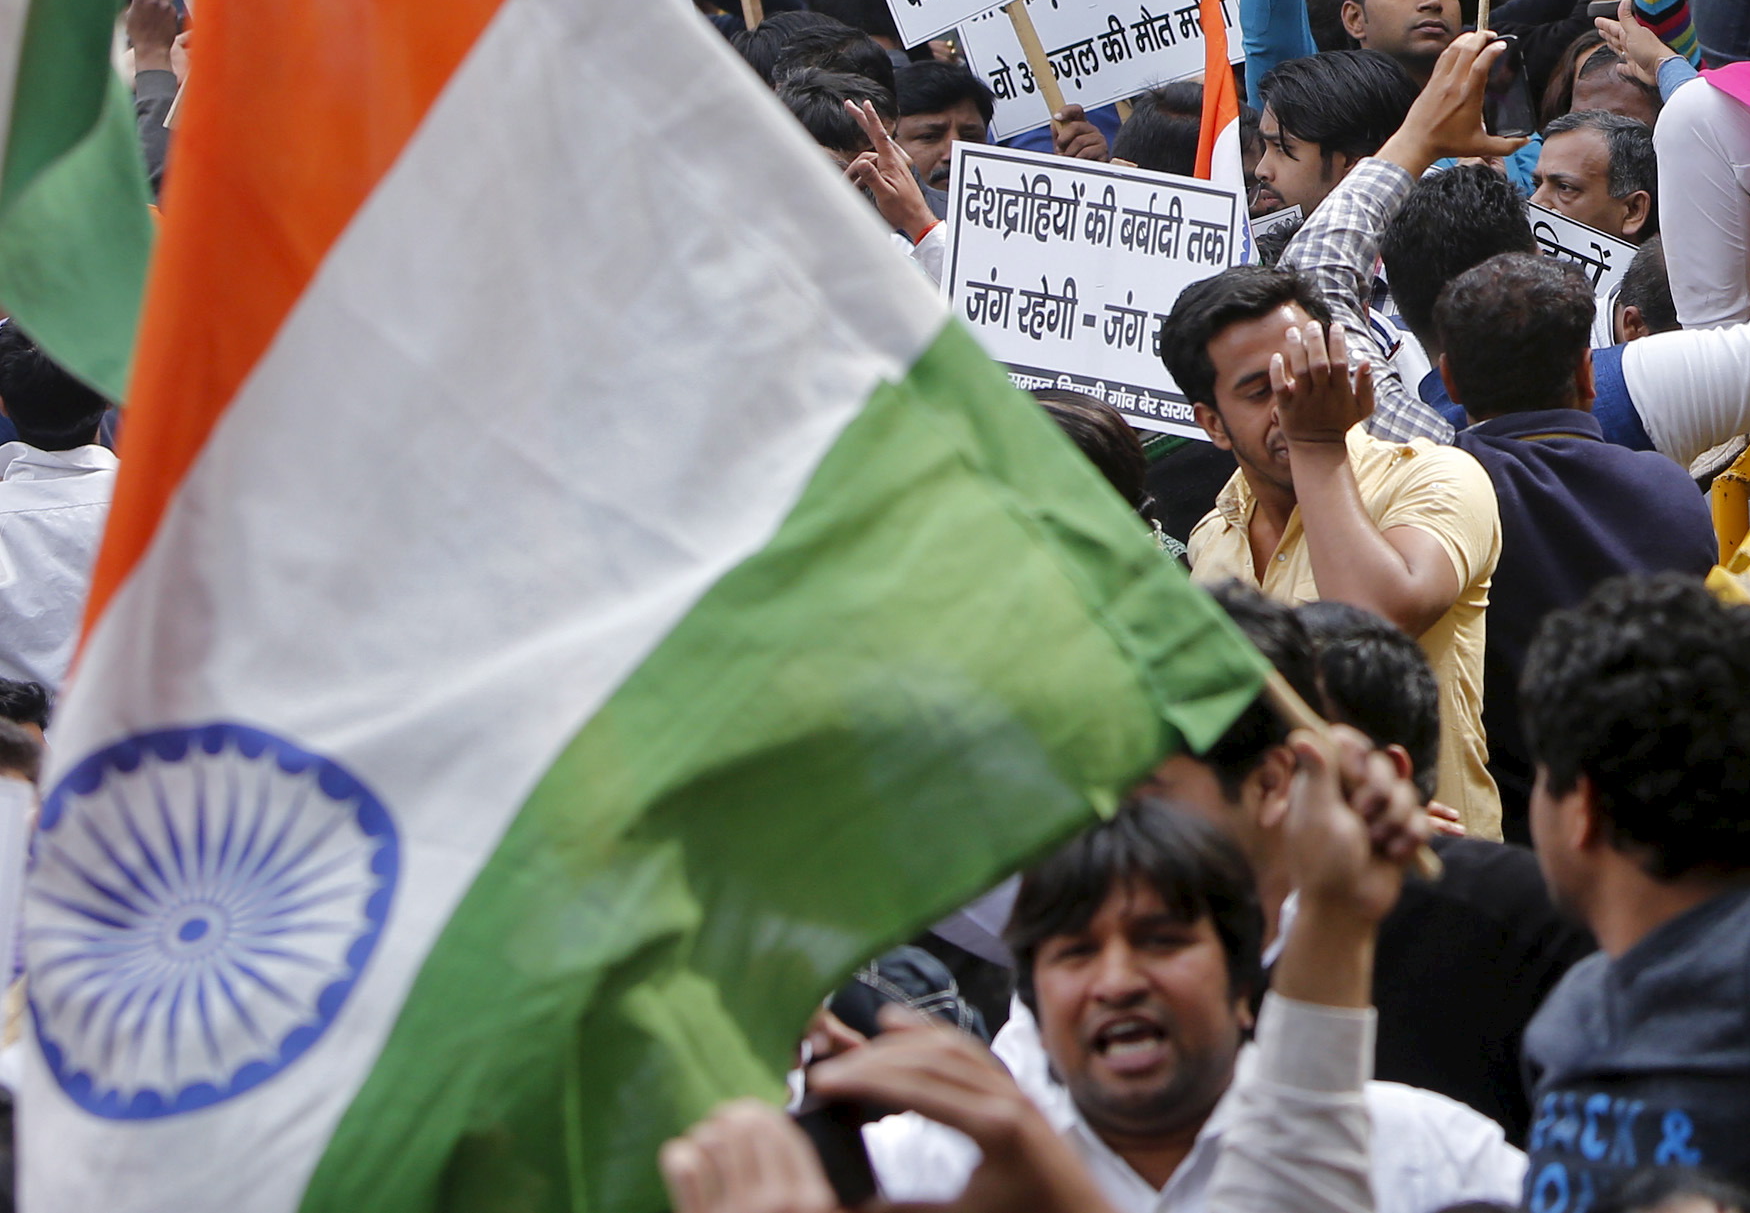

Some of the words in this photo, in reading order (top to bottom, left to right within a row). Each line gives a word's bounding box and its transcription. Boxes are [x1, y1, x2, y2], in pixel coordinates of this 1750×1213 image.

[988, 54, 1018, 102] वो
[1097, 13, 1133, 65] की
[1130, 4, 1177, 55] मौत
[965, 165, 1086, 243] देशद्रोहियों
[1085, 184, 1117, 249] की
[1120, 192, 1184, 260] बर्बादी
[1187, 219, 1229, 267] तक
[965, 266, 1014, 330] जंग
[1017, 274, 1079, 341] रहेगी
[1103, 290, 1148, 354] जंग
[1138, 390, 1160, 416] बेर
